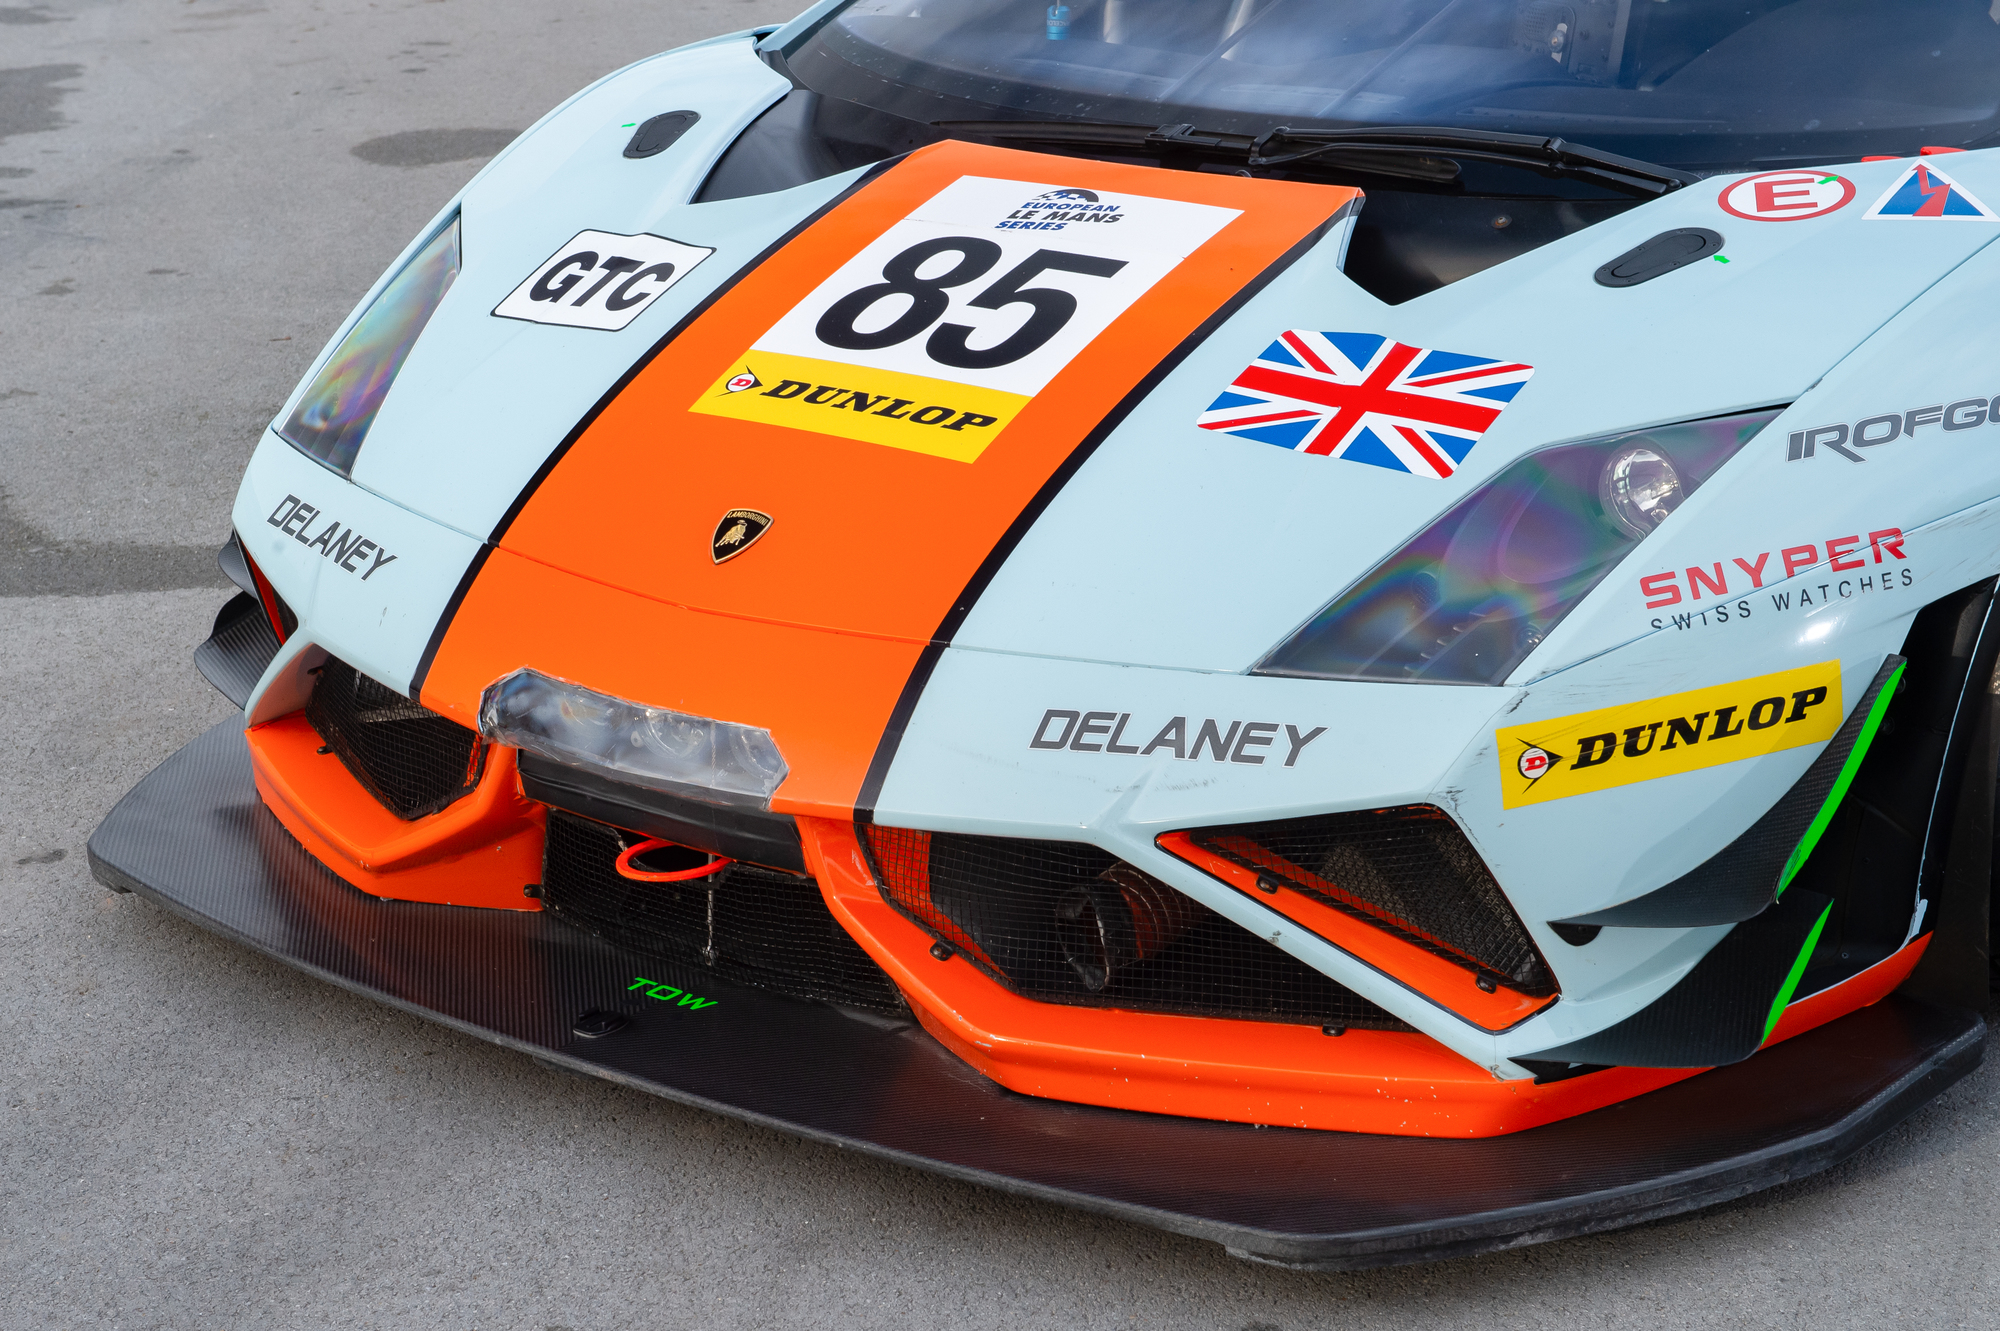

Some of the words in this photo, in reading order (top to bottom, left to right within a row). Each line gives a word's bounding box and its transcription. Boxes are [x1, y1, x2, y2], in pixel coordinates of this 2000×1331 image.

[994, 220, 1068, 230] SERIES
[1006, 209, 1040, 219] LE
[1041, 211, 1125, 223] MANS
[1021, 201, 1121, 212] EUROPEAN
[1754, 177, 1818, 213] E
[529, 250, 675, 312] GTC
[815, 236, 1129, 369] 85
[760, 379, 998, 432] DUNLOP
[1786, 393, 2000, 464] IROFG
[266, 493, 399, 582] DELANEY
[727, 511, 768, 526] LAMBORGHINI
[1639, 527, 1908, 610] SNYPER
[1650, 600, 1751, 631] SWISS
[1771, 568, 1914, 612] WATCHES
[1028, 708, 1330, 768] DELANEY
[1569, 686, 1827, 771] DUNLOP
[627, 976, 719, 1010] TOW
